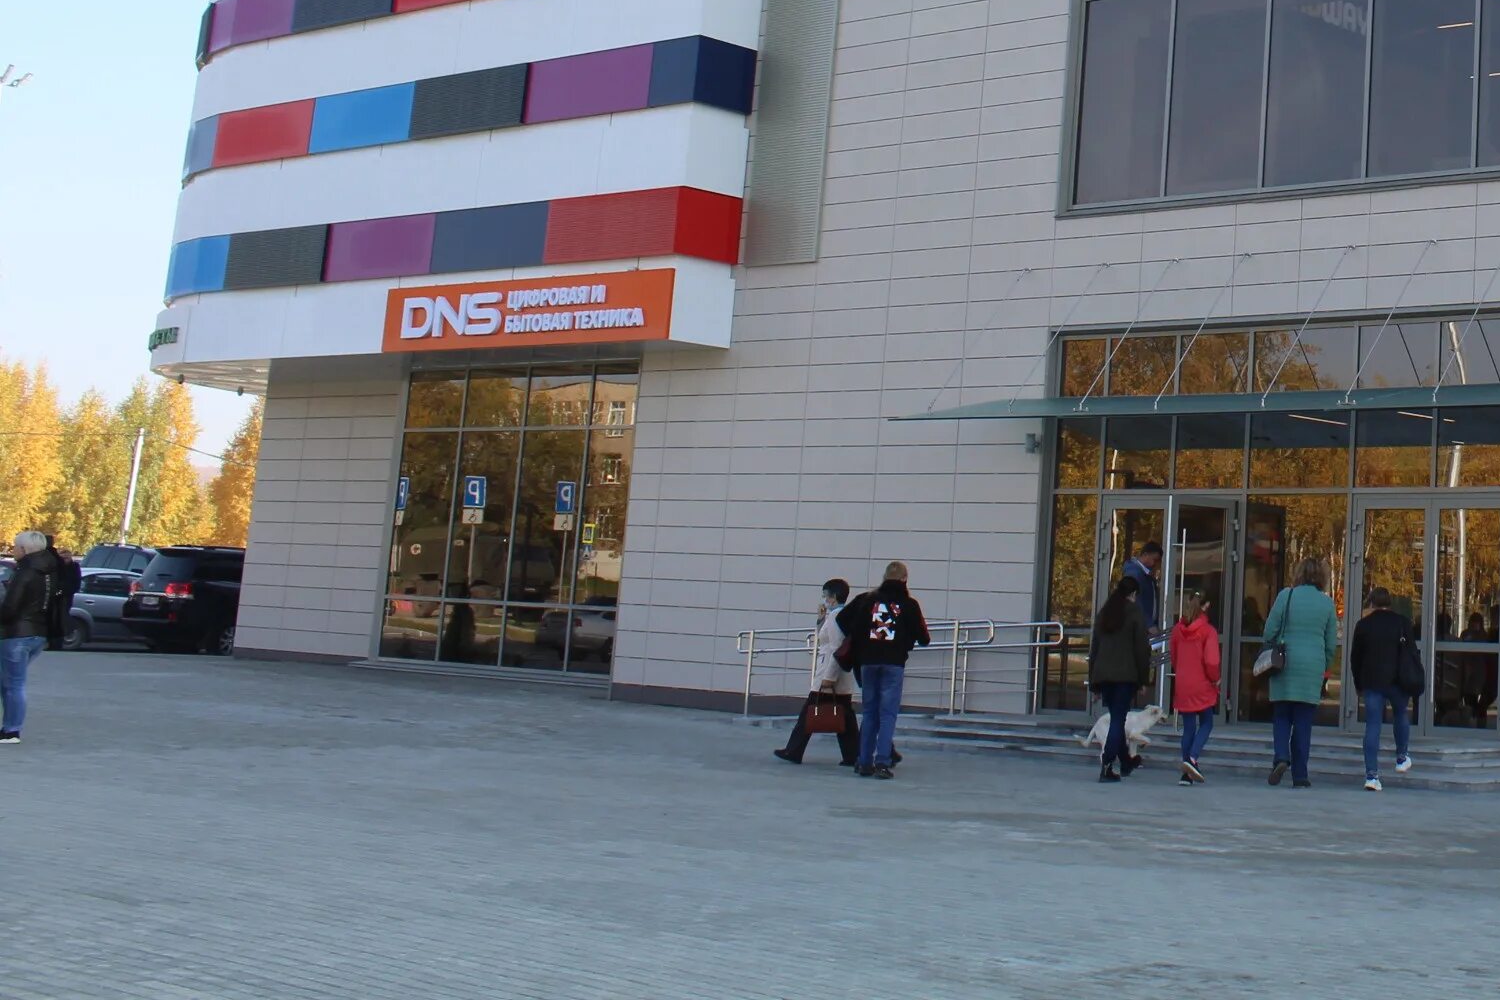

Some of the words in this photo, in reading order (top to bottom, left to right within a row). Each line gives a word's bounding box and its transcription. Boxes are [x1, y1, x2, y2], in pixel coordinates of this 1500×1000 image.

[507, 286, 588, 311] ЦИФРОВАЯ
[590, 284, 607, 304] И
[400, 291, 502, 339] DNS
[504, 311, 572, 334] БЫТОВАЯ
[574, 307, 645, 330] ТЕХНИКА
